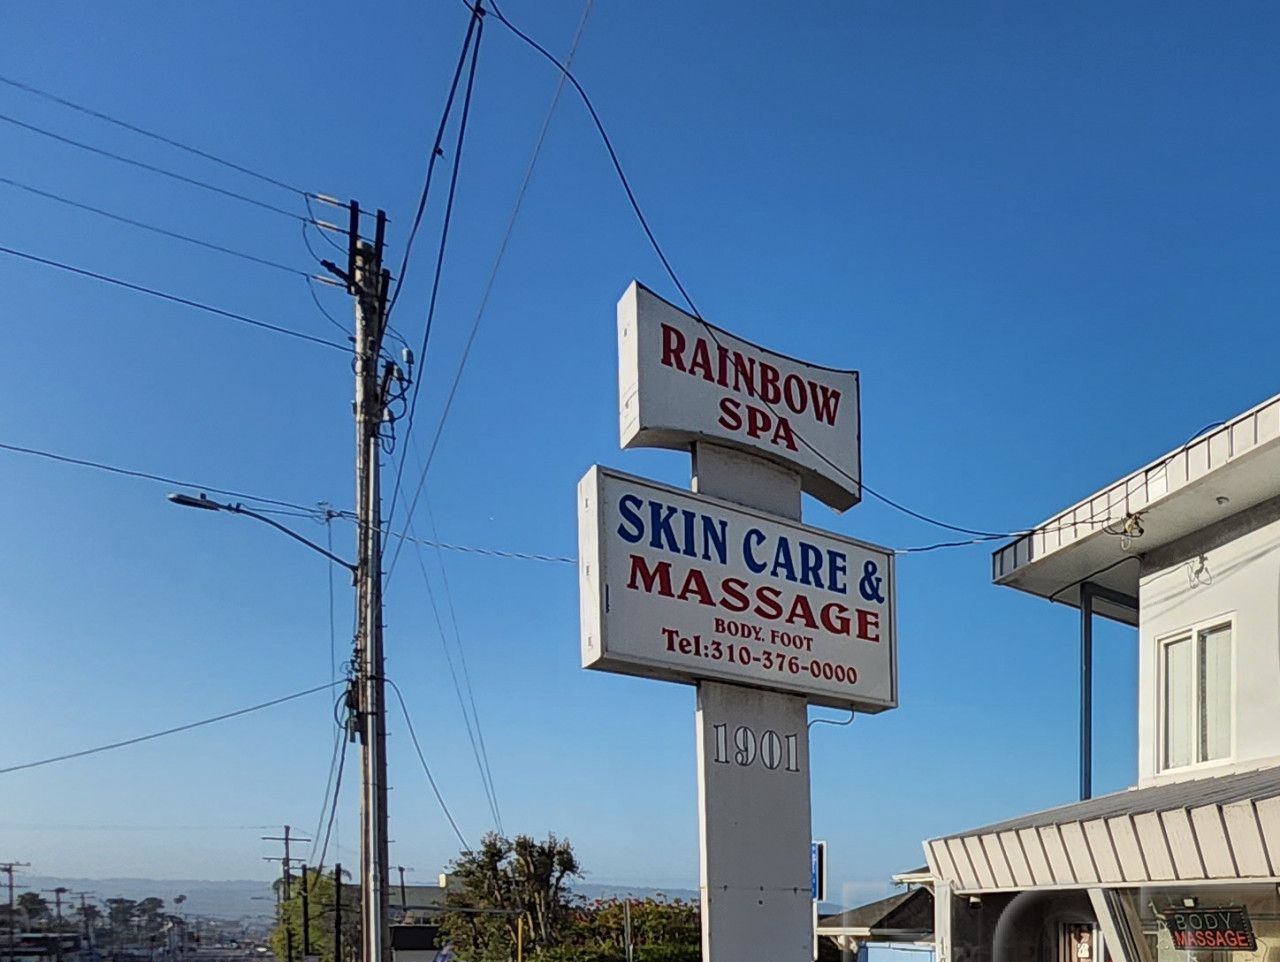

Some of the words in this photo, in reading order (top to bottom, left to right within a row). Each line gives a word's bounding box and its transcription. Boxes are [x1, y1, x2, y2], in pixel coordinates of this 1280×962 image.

[661, 323, 841, 427] RAINBOW
[718, 397, 798, 451] SPA
[617, 494, 727, 565] SKIN
[743, 528, 847, 594] CARE
[859, 559, 885, 603] &
[626, 554, 880, 643] MASSAGE
[661, 627, 857, 685] Tel:310-376-0000
[770, 629, 813, 652] FOOT
[713, 722, 800, 773] 1901
[1174, 913, 1233, 931] BODY
[1174, 930, 1249, 948] MASSAGE
